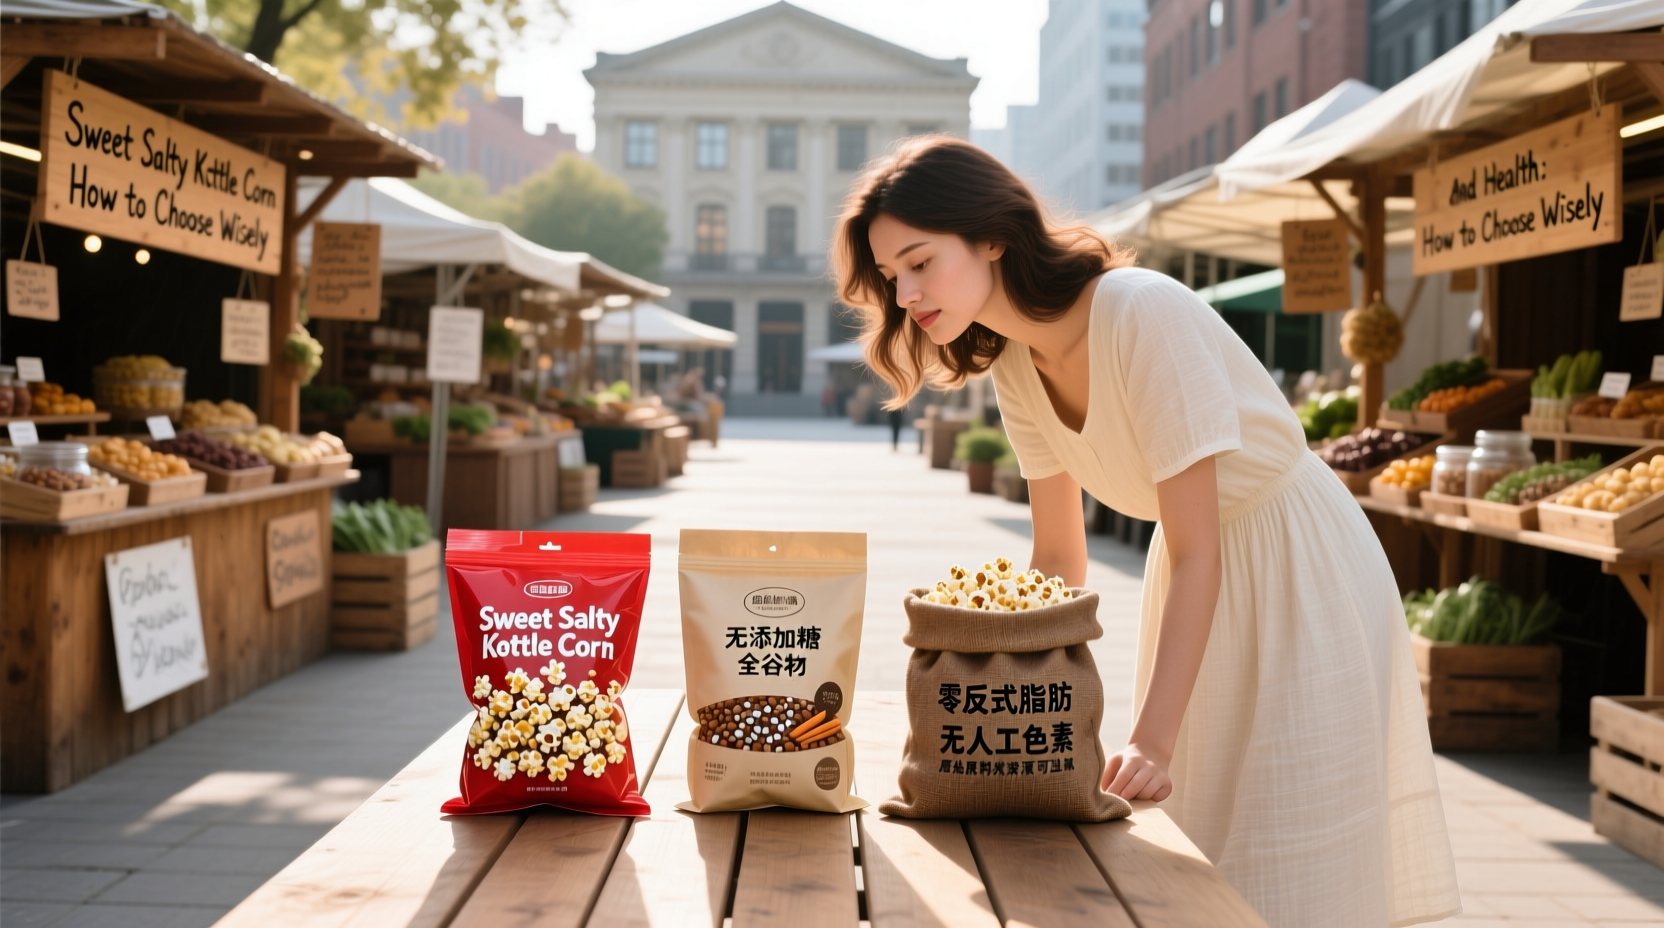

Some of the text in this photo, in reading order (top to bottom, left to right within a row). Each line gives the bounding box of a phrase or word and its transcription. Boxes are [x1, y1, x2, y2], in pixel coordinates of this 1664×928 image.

[65, 101, 134, 161] Sweet
[140, 128, 188, 190] Salty
[243, 167, 276, 209] Corn
[1449, 149, 1547, 206] And Health:
[69, 163, 269, 261] How to Choose Wisely
[1423, 182, 1604, 258] How to Choose Wisely
[479, 605, 621, 638] Sweet Salty
[725, 626, 822, 650] 无添加糖
[482, 632, 615, 660] Kottle Corn
[737, 652, 807, 677] 全谷物
[938, 681, 1073, 715] 零反式脂肪
[939, 721, 1074, 756] 无人工色素
